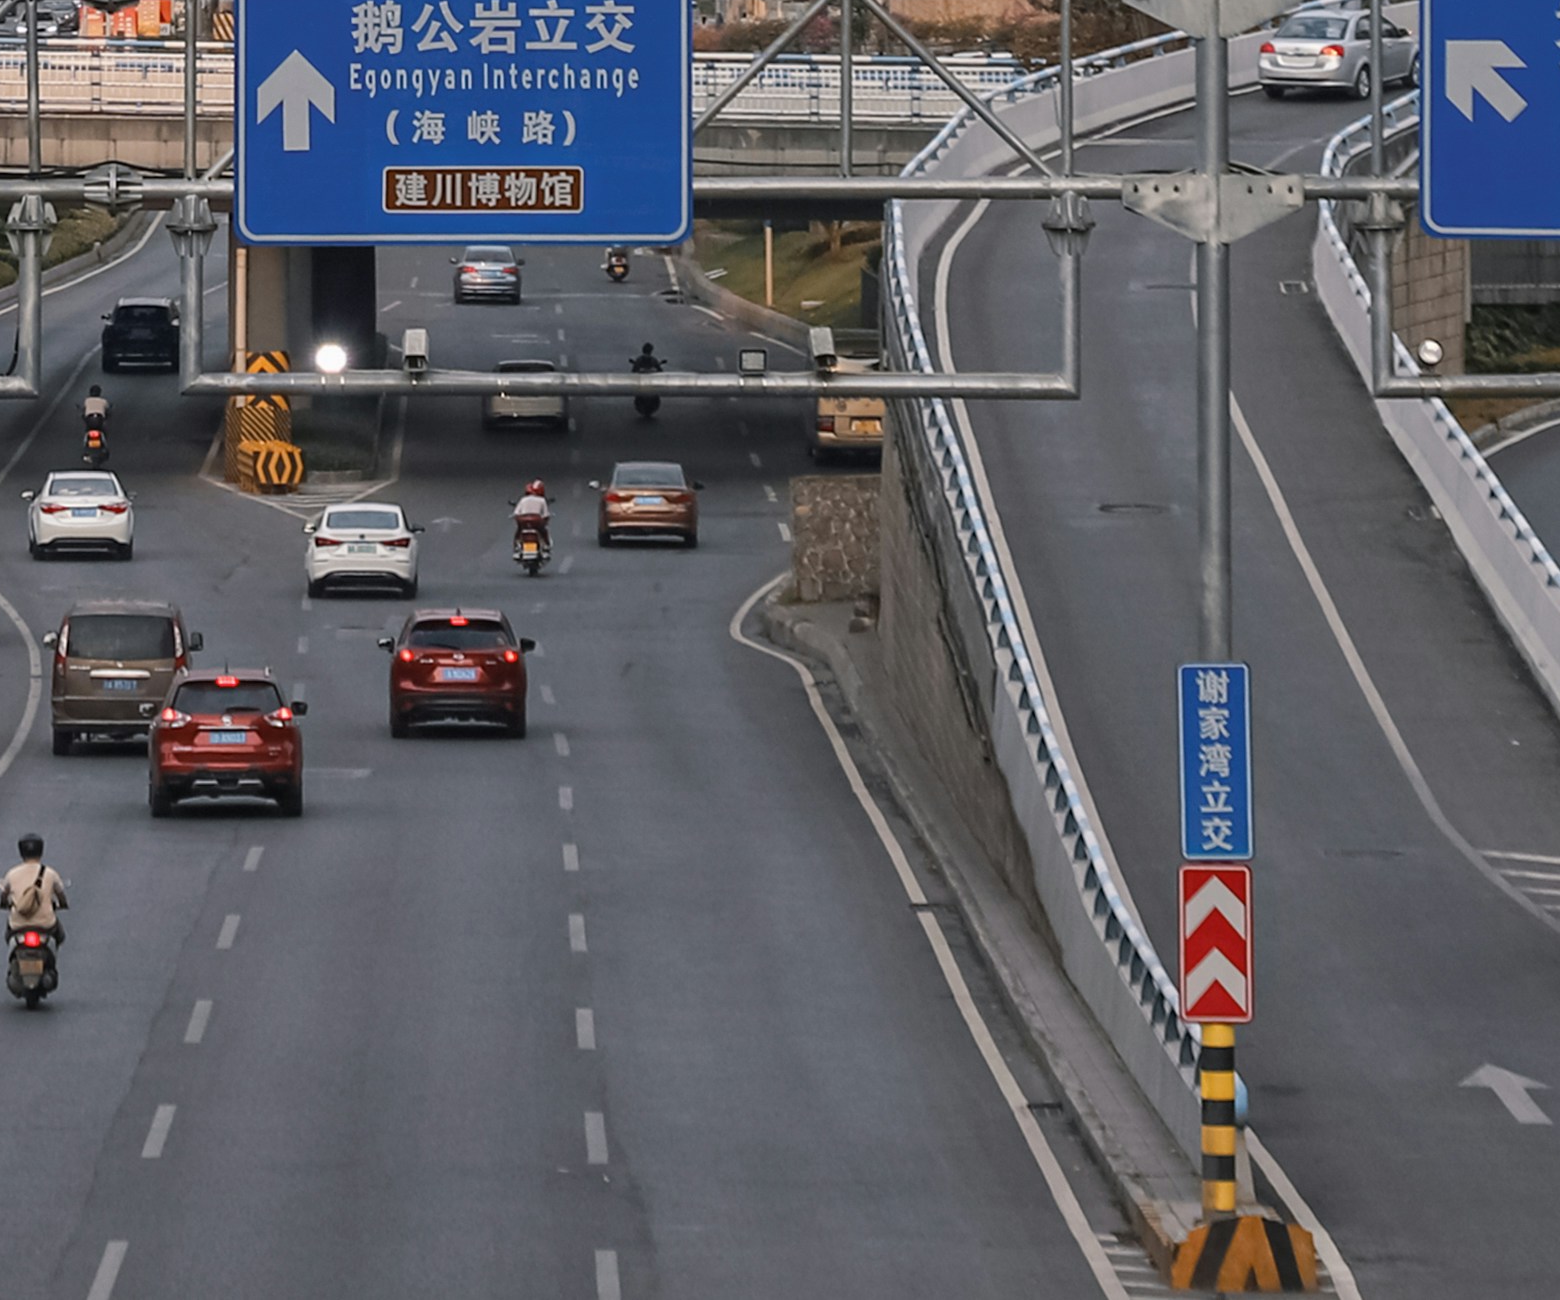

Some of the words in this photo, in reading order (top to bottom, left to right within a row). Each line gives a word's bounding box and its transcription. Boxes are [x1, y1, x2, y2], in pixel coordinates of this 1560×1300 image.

[350, 0, 636, 55] 鹅公岩立交
[350, 63, 472, 98] Egongyan
[483, 63, 639, 98] Interchange
[385, 109, 577, 147] (海峡路)
[395, 172, 575, 208] 建川博物馆
[1195, 669, 1234, 853] 谢家湾立交
